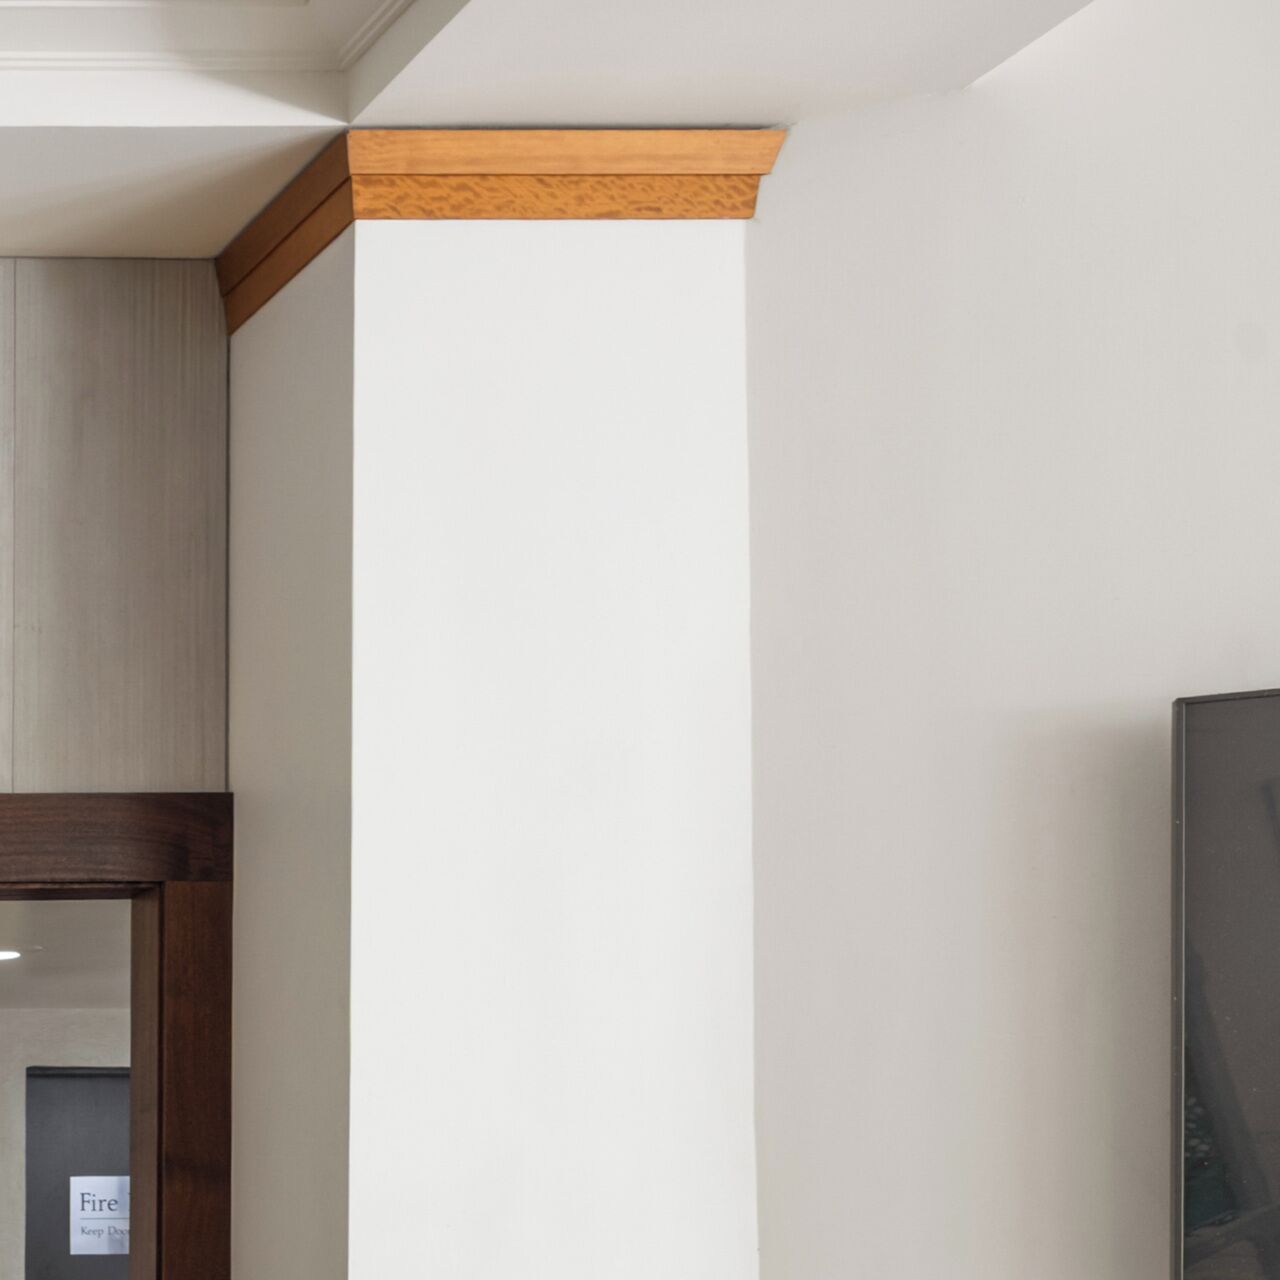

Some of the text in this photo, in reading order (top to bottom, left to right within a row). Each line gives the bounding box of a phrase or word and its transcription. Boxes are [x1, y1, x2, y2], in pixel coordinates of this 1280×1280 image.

[80, 1192, 119, 1212] Fire
[80, 1225, 130, 1239] Keep Doo
